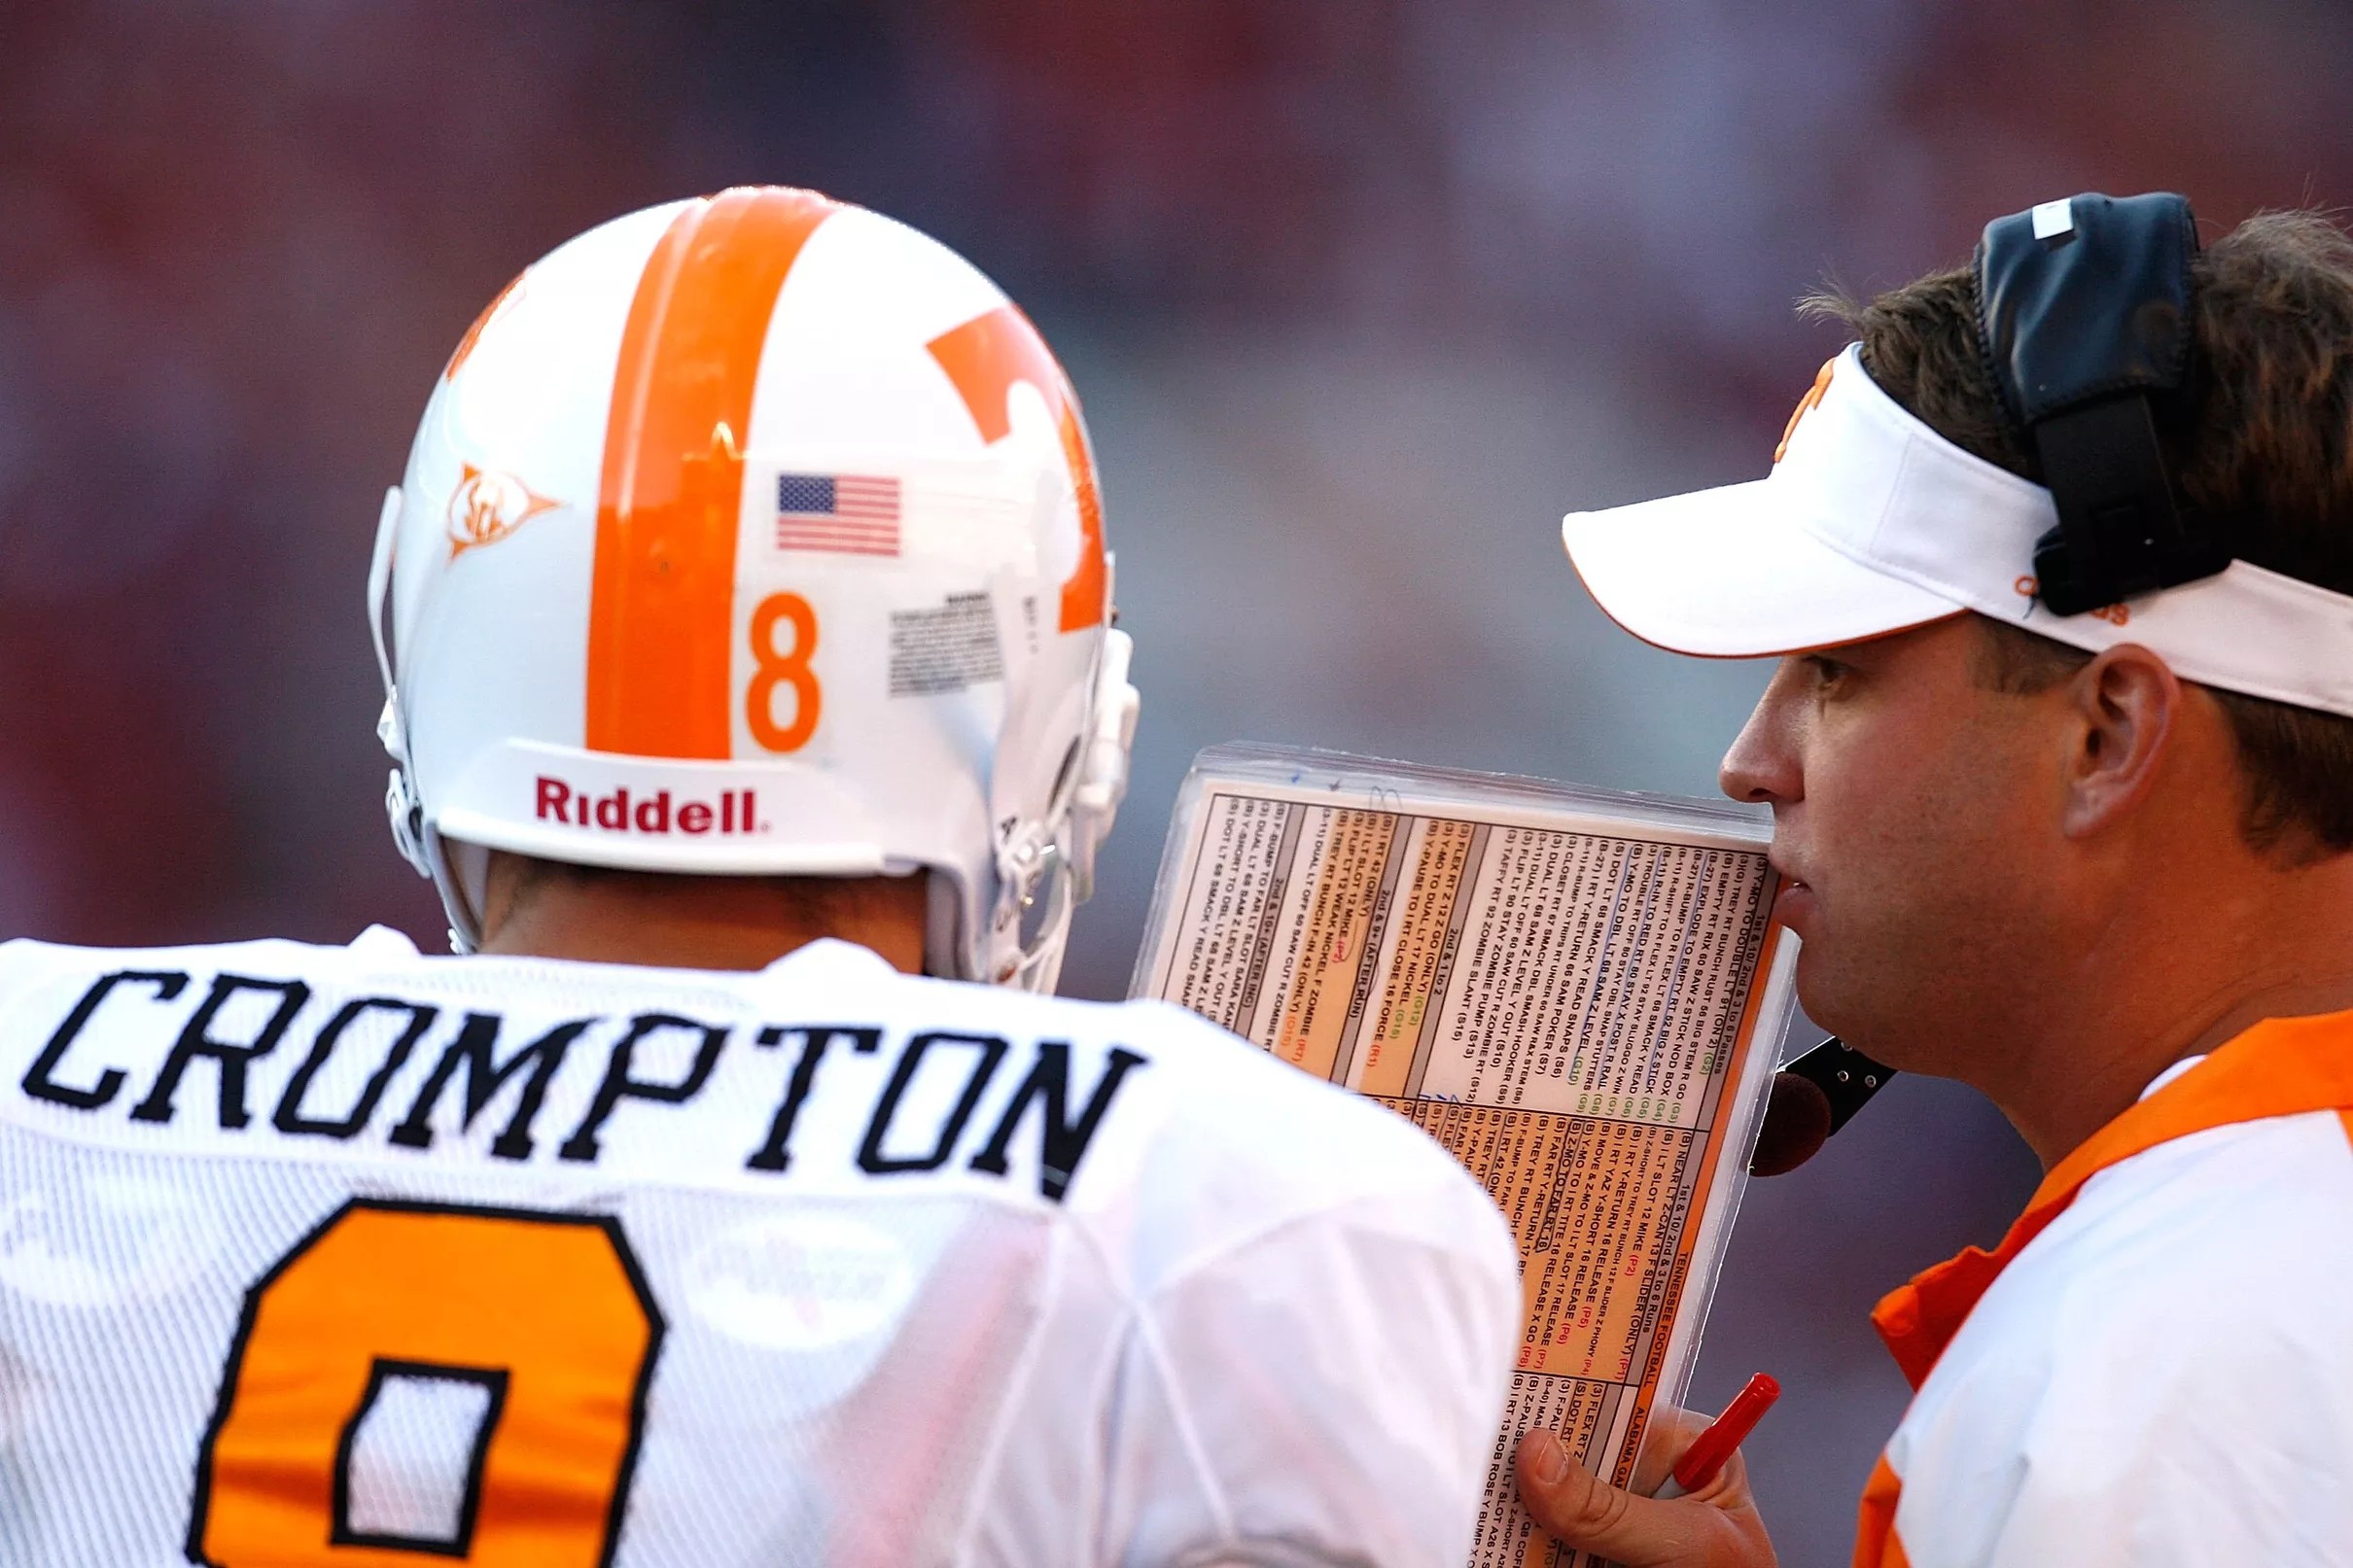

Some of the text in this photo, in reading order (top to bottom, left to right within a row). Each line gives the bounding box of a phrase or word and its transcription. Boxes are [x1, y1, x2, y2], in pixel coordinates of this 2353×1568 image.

[745, 590, 823, 753] 8
[536, 775, 756, 837] Riddell
[1550, 834, 1563, 850] (3)
[1612, 841, 1626, 857] (S)
[1592, 839, 1610, 873] (B-27)
[1721, 851, 1737, 869] (B)
[1542, 852, 1559, 884] DUAL
[1606, 859, 1621, 885] DOT
[1734, 854, 1749, 884] (3)(G)
[1537, 887, 1550, 902] LT
[1586, 882, 1598, 898] RT
[1601, 888, 1614, 903] LT
[1712, 872, 1730, 911] EMPTY
[1727, 886, 1741, 915] TREY
[1532, 904, 1544, 918] 68
[1597, 905, 1608, 919] 68
[1707, 913, 1719, 929] RT
[1525, 921, 1539, 947] SAM
[1568, 901, 1593, 960] Y-RETURN
[1722, 916, 1734, 931] RT
[1445, 928, 1459, 950] 2nd
[1462, 830, 1534, 1060] (3) FLIP LT 90 STAY ZOMBIE PUMP (S13)
[1584, 921, 1604, 963] SMACK
[1701, 931, 1714, 951] RIX
[1697, 953, 1708, 966] 60
[1710, 933, 1729, 972] BUNCH
[1436, 973, 1447, 986] to
[1510, 959, 1528, 997] LEVEL
[1563, 963, 1575, 977] 66
[1689, 968, 1703, 995] SAW
[1556, 979, 1570, 1006] SAM
[1571, 977, 1588, 1011] READ
[1703, 973, 1718, 1003] RUST
[1698, 1004, 1709, 1018] 56
[1500, 1011, 1514, 1036] OUT
[1543, 1008, 1563, 1050] POKER
[1559, 1013, 1578, 1053] SNAPS
[1675, 1007, 1693, 1041] STICK
[1693, 1019, 1705, 1038] BIG
[1490, 1039, 1506, 1068] (S10)
[1534, 1053, 1550, 1075] (S7)
[1668, 1043, 1683, 1069] NOD
[1683, 1041, 1699, 1070] STEM
[1550, 1056, 1565, 1079] (S6)
[20, 969, 1152, 1202] CROMPTON
[1660, 1071, 1675, 1096] BOX
[1675, 1083, 1687, 1100] GO
[1598, 1121, 1612, 1136] (B)
[1613, 1123, 1628, 1140] (B)
[1629, 1125, 1643, 1142] (B)
[1661, 1129, 1674, 1146] (B)
[1590, 1138, 1607, 1170] MOVE
[1608, 1149, 1621, 1166] RT
[1624, 1151, 1636, 1167] RT
[1656, 1154, 1668, 1170] LT
[1600, 1167, 1616, 1192] YAZ
[1646, 1171, 1663, 1203] SLOT
[1579, 1182, 1595, 1211] Z-MO
[1606, 1169, 1632, 1230] Y-RETURN
[1678, 1184, 1691, 1202] 1st
[1574, 1213, 1586, 1229] TO
[1586, 1194, 1608, 1246] Y-SHORT
[1641, 1206, 1653, 1220] 12
[1669, 1216, 1682, 1233] 10/
[1567, 1236, 1580, 1250] LT
[1601, 1233, 1613, 1245] 16
[1633, 1222, 1649, 1251] MIKE
[1663, 1234, 1677, 1256] 2nd
[1560, 1251, 1575, 1280] SLOT
[1580, 1248, 1592, 1262] 16
[1624, 1254, 1639, 1276] (P2)
[1586, 1248, 1609, 1303] RELEASE
[1653, 1279, 1665, 1292] to
[1662, 1252, 1689, 1322] TENNESSEE
[1556, 1282, 1565, 1295] 17
[1564, 1265, 1588, 1319] RELEASE
[1540, 1297, 1563, 1346] RELEASE
[1577, 1306, 1593, 1329] (P5)
[1642, 1304, 1659, 1334] Runs
[1556, 1322, 1571, 1345] (P6)
[1532, 1348, 1547, 1370] (P7)
[1643, 1324, 1668, 1387] FOOTBALL
[1511, 1374, 1525, 1390] (B)
[1590, 1383, 1604, 1398] (3)
[1505, 1399, 1518, 1416] RT
[1581, 1400, 1599, 1431] FLEX
[1500, 1418, 1512, 1432] 13
[1621, 1407, 1645, 1464] ALABAMA
[1493, 1434, 1508, 1460] BOB
[1576, 1433, 1590, 1449] RT
[1484, 1463, 1500, 1497] ROSE
